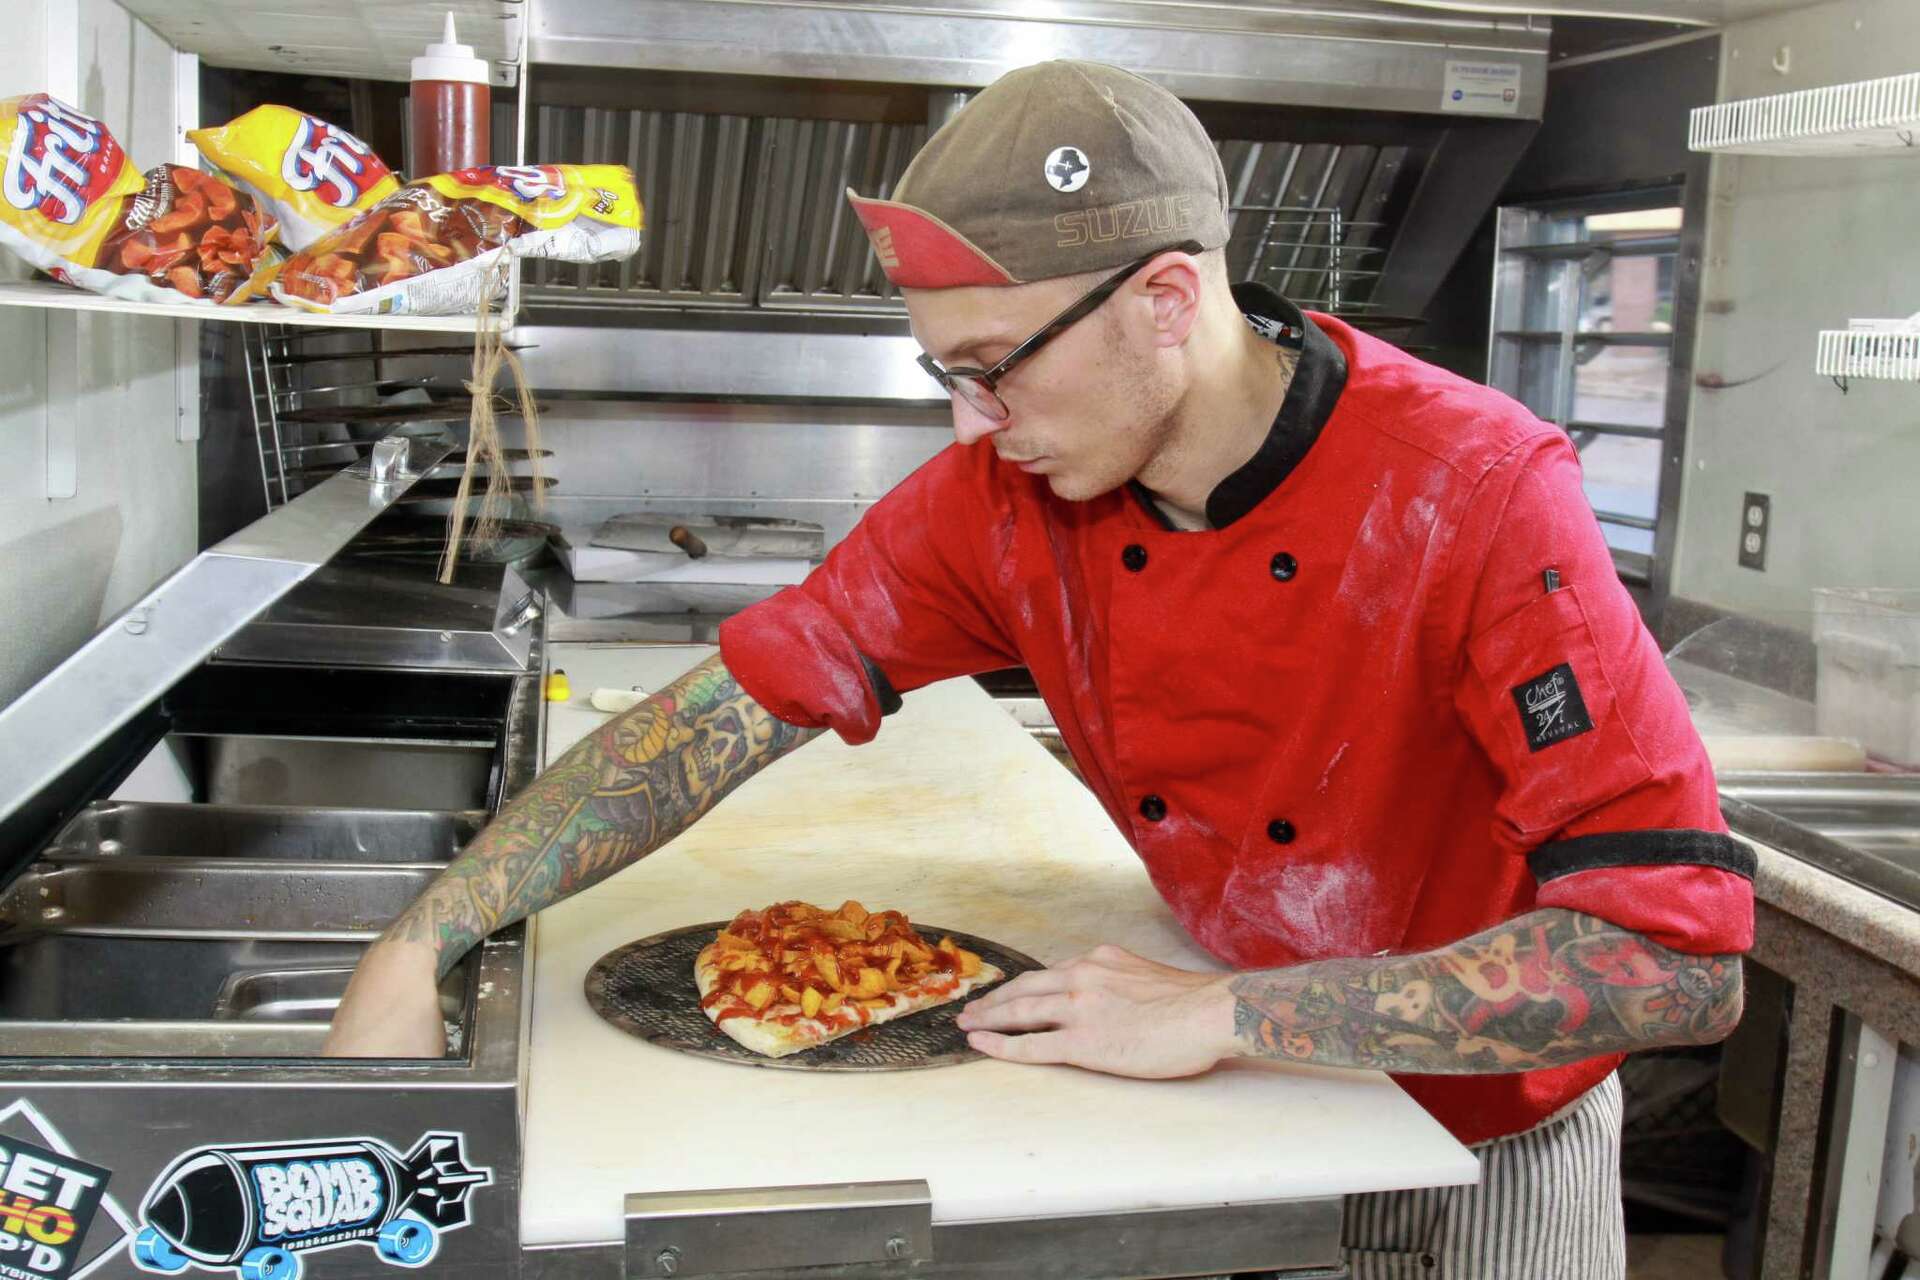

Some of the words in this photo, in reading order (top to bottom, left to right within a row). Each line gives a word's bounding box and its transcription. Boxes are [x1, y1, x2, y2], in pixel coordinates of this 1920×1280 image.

[1525, 671, 1562, 706] Chef
[255, 1160, 379, 1204] BOMB
[263, 1190, 380, 1236] SQUAD
